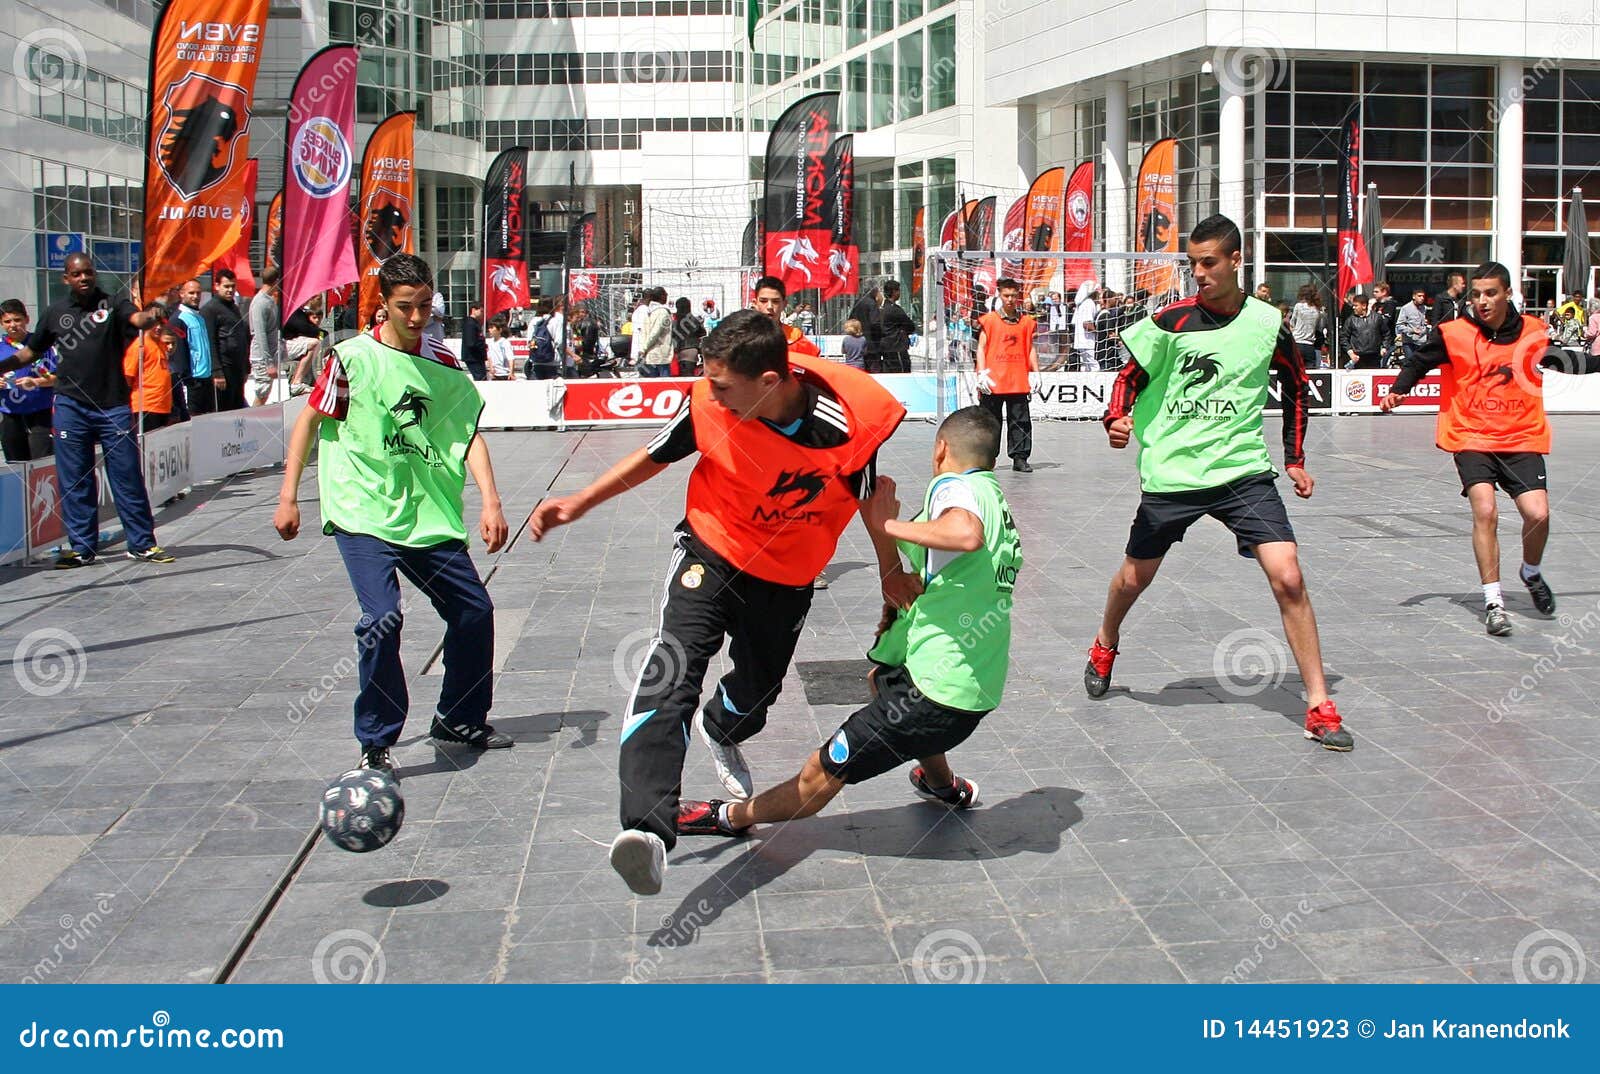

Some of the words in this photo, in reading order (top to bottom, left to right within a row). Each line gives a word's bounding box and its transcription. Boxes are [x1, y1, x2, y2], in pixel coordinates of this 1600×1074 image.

[1037, 384, 1104, 403] VBN
[1166, 399, 1238, 415] MONTA
[1467, 399, 1527, 411] MONTA
[158, 441, 184, 483] SVBN
